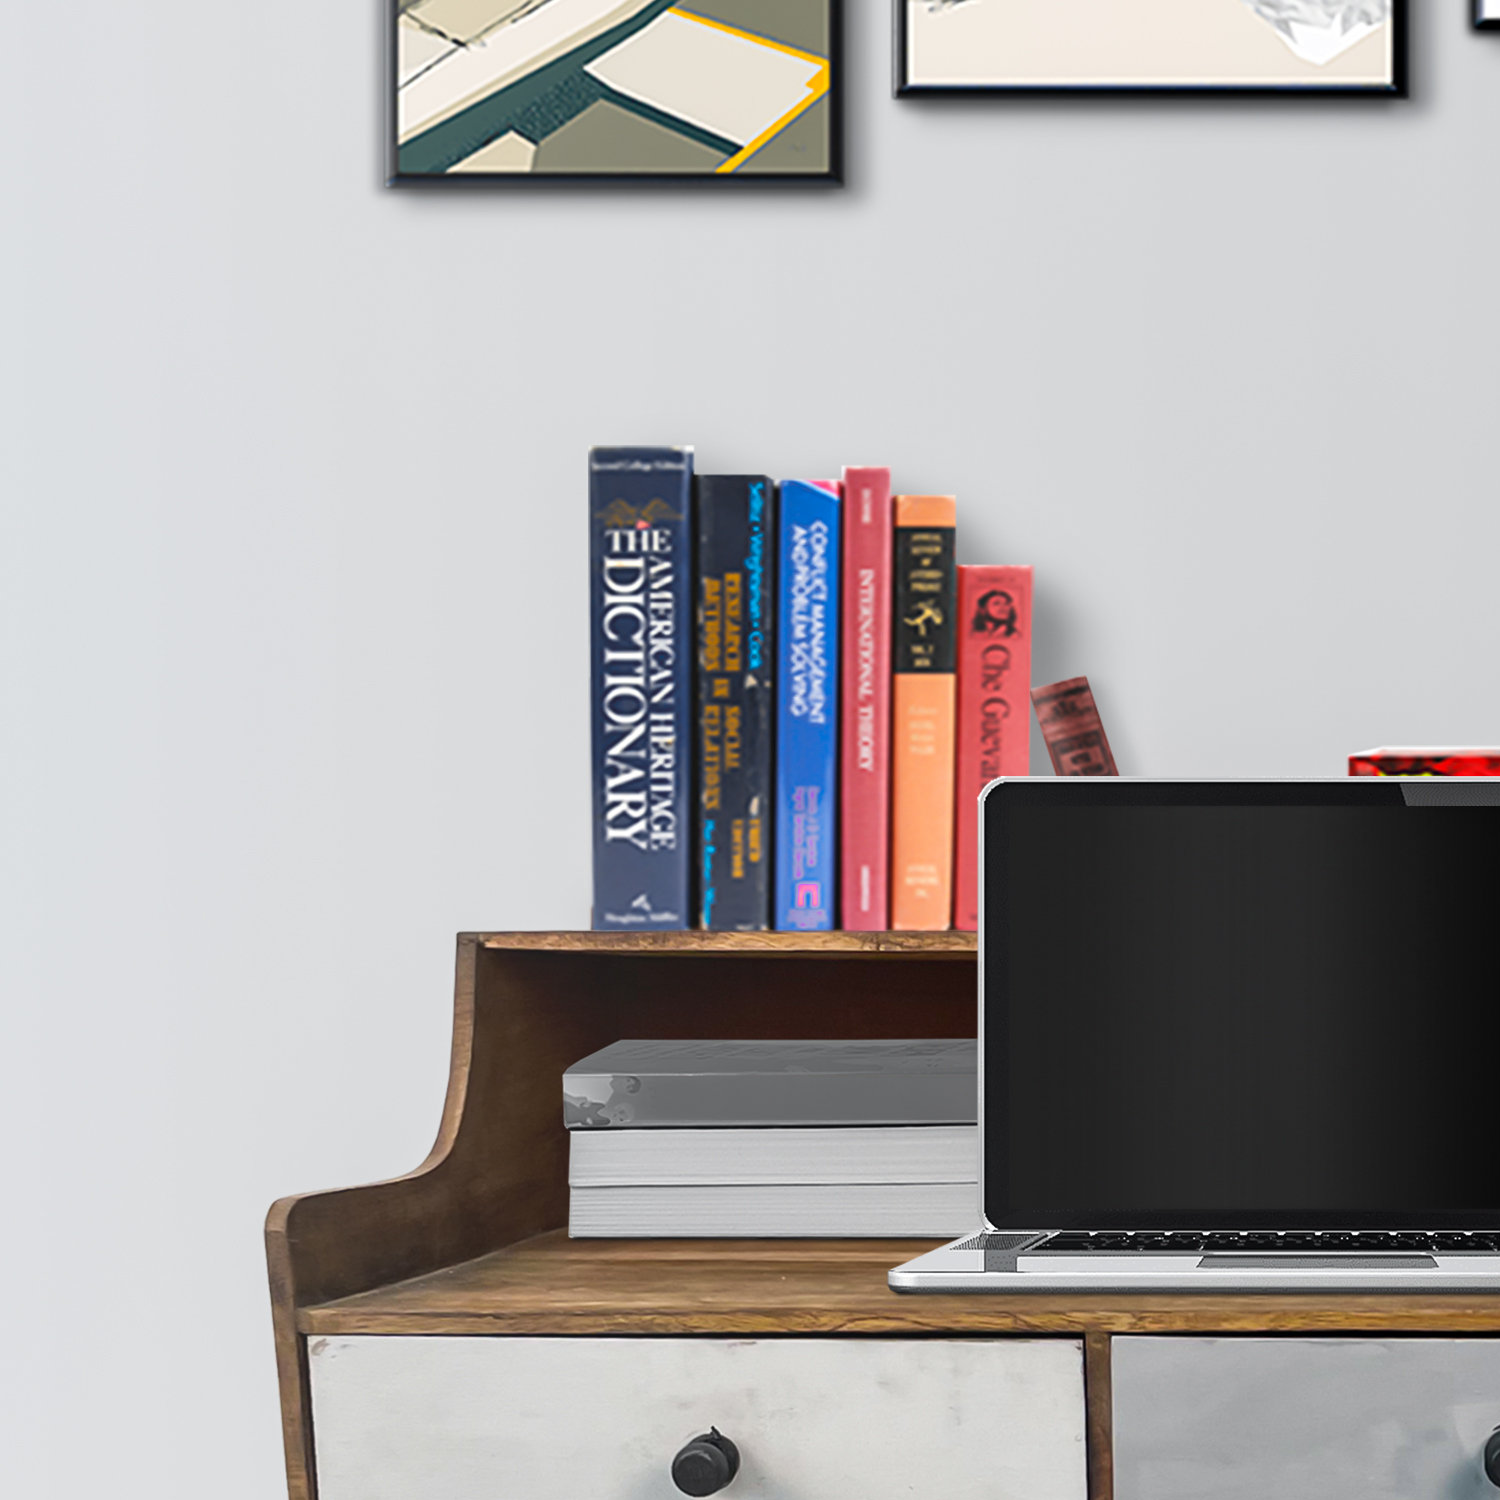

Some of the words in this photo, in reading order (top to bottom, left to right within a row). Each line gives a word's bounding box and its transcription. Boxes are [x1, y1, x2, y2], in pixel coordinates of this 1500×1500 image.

[605, 529, 672, 553] THE
[809, 520, 828, 601] CONFLICT
[648, 556, 674, 703] AMERICAN
[724, 572, 741, 671] RESEARCH
[748, 631, 764, 669] Cook
[809, 604, 826, 724] MANAGEMENT
[859, 568, 874, 701] INTERNATIONAL
[981, 644, 1011, 691] Che
[603, 556, 648, 850] DICTIONARY
[790, 642, 812, 717] SOLVING
[649, 713, 676, 850] HERITAGE
[858, 705, 873, 772] THEORY
[981, 697, 1010, 789] Guevar
